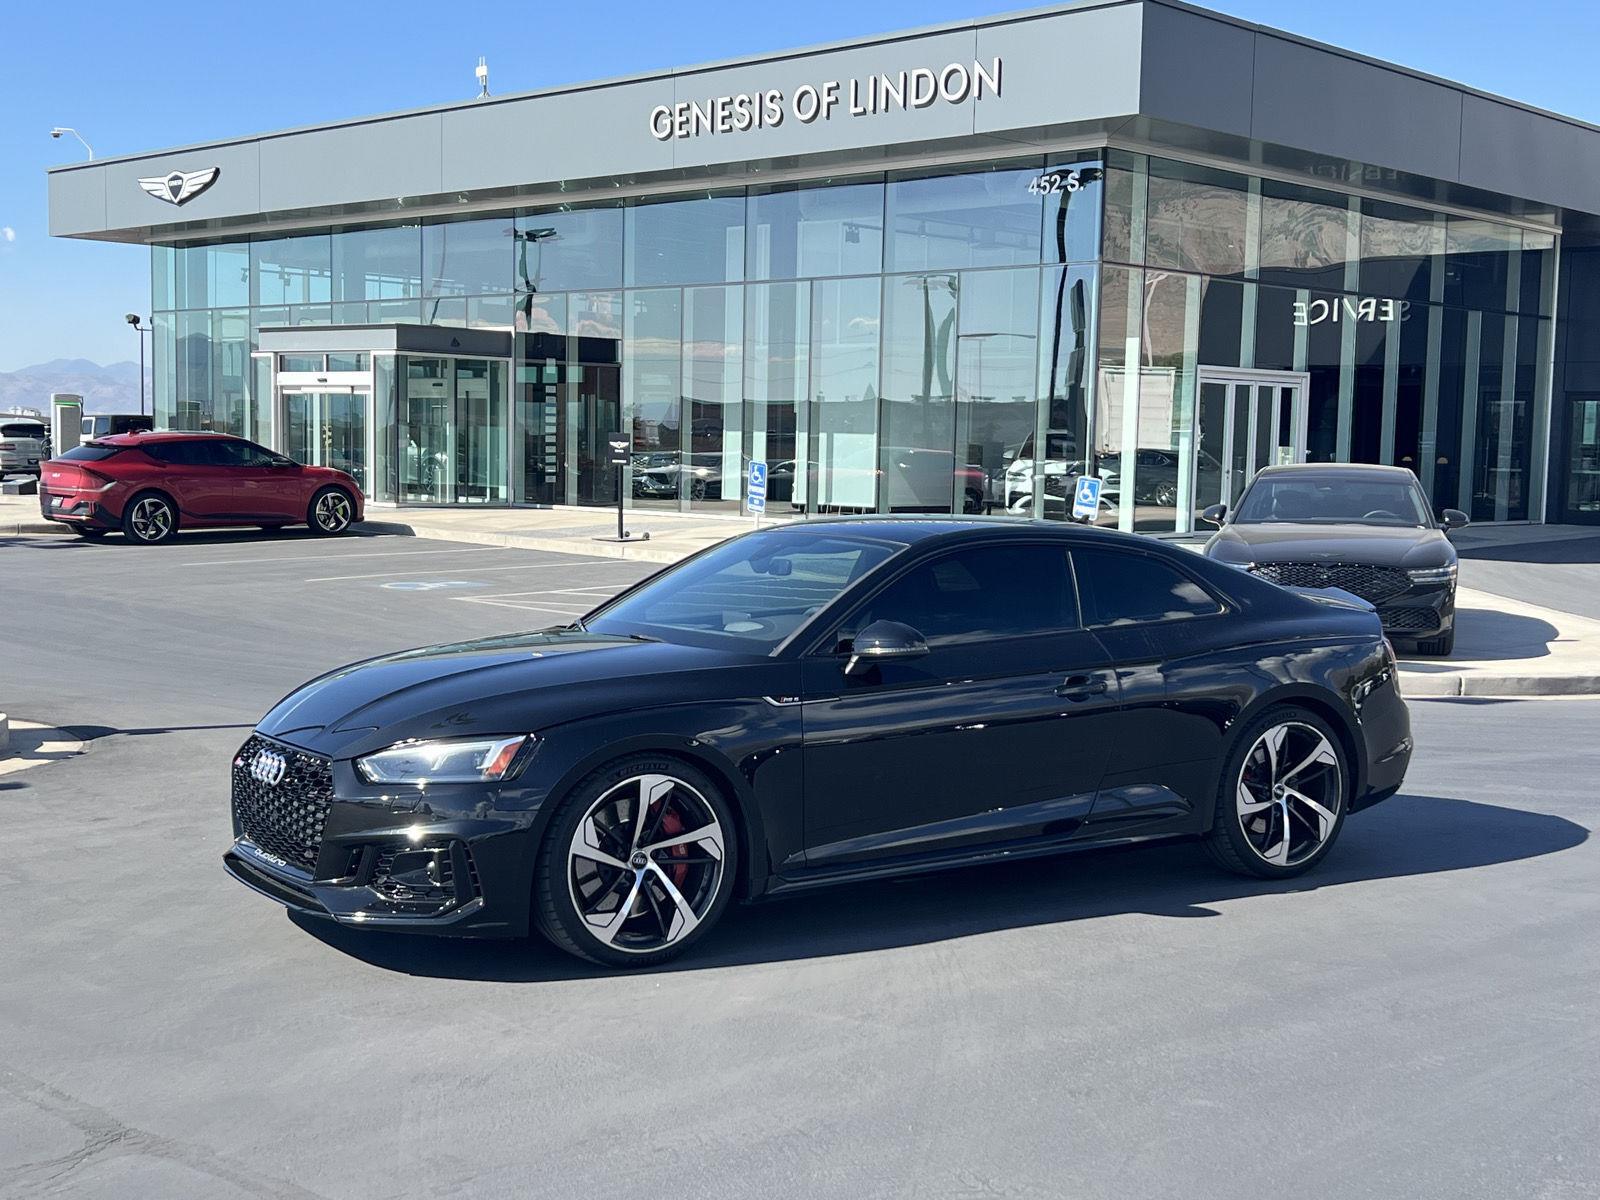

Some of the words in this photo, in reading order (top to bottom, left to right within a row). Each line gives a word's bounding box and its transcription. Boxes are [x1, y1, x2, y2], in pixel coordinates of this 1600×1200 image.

[650, 88, 783, 141] GENESIS
[793, 80, 840, 124] OF
[850, 56, 1003, 117] LINDON
[1028, 174, 1060, 196] 452
[1067, 172, 1084, 193] S.
